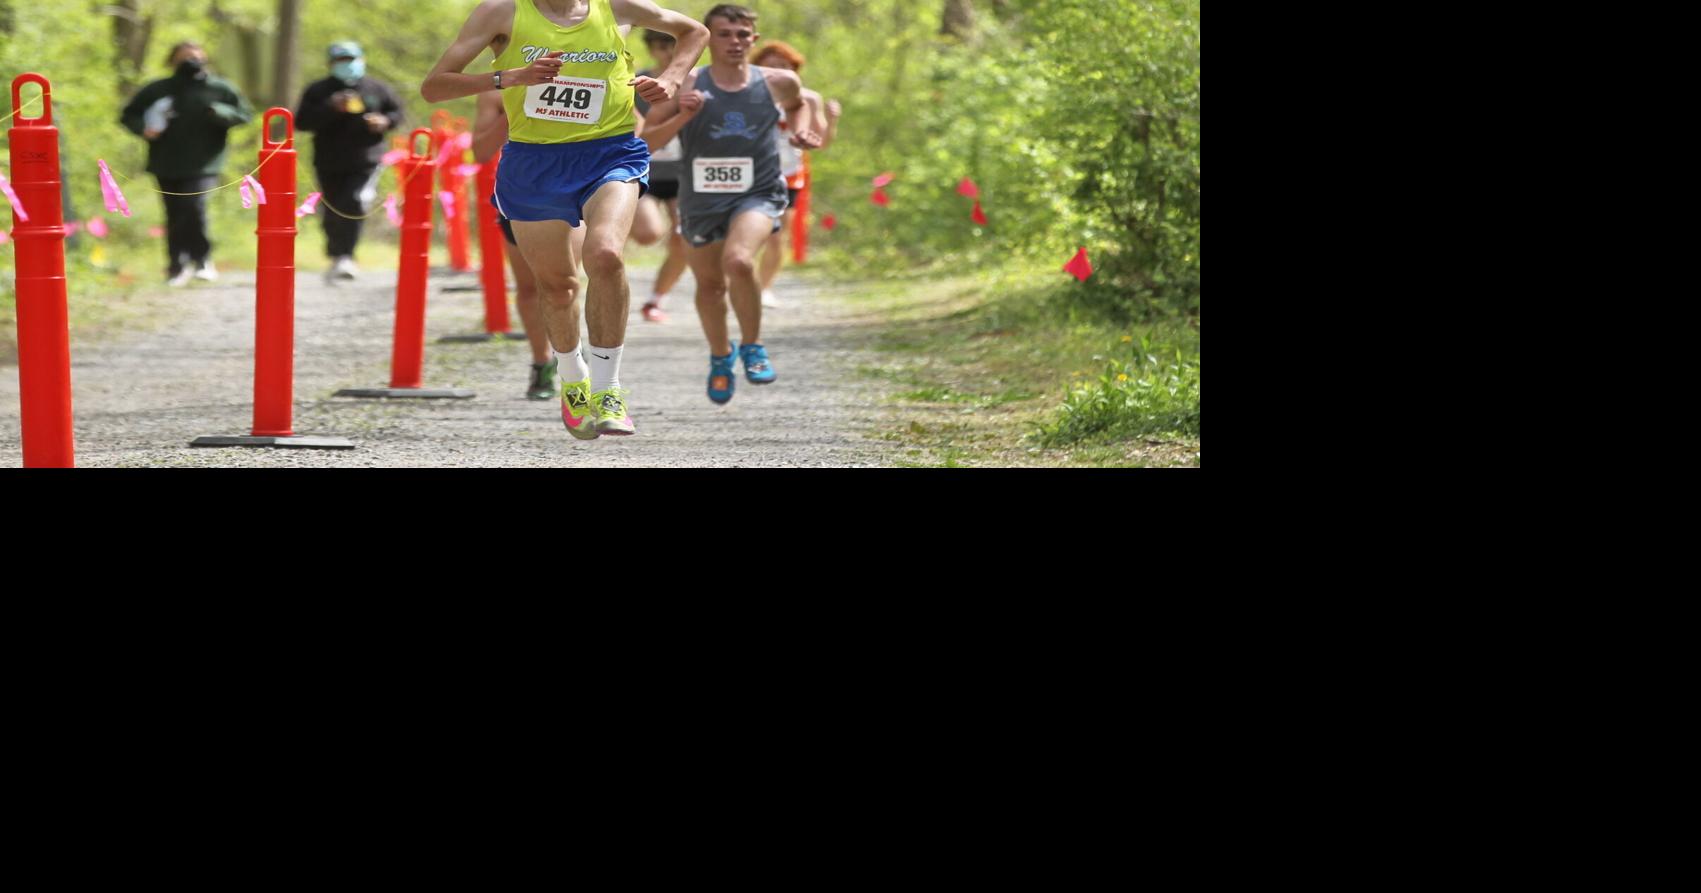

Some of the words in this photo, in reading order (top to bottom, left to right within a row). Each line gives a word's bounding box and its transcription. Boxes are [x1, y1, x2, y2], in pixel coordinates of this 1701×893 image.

[521, 45, 618, 63] Wrriors
[552, 80, 604, 89] HAMPIONSHIPS
[539, 85, 592, 110] 449
[548, 109, 590, 119] ATHLETIC
[704, 166, 742, 182] 358
